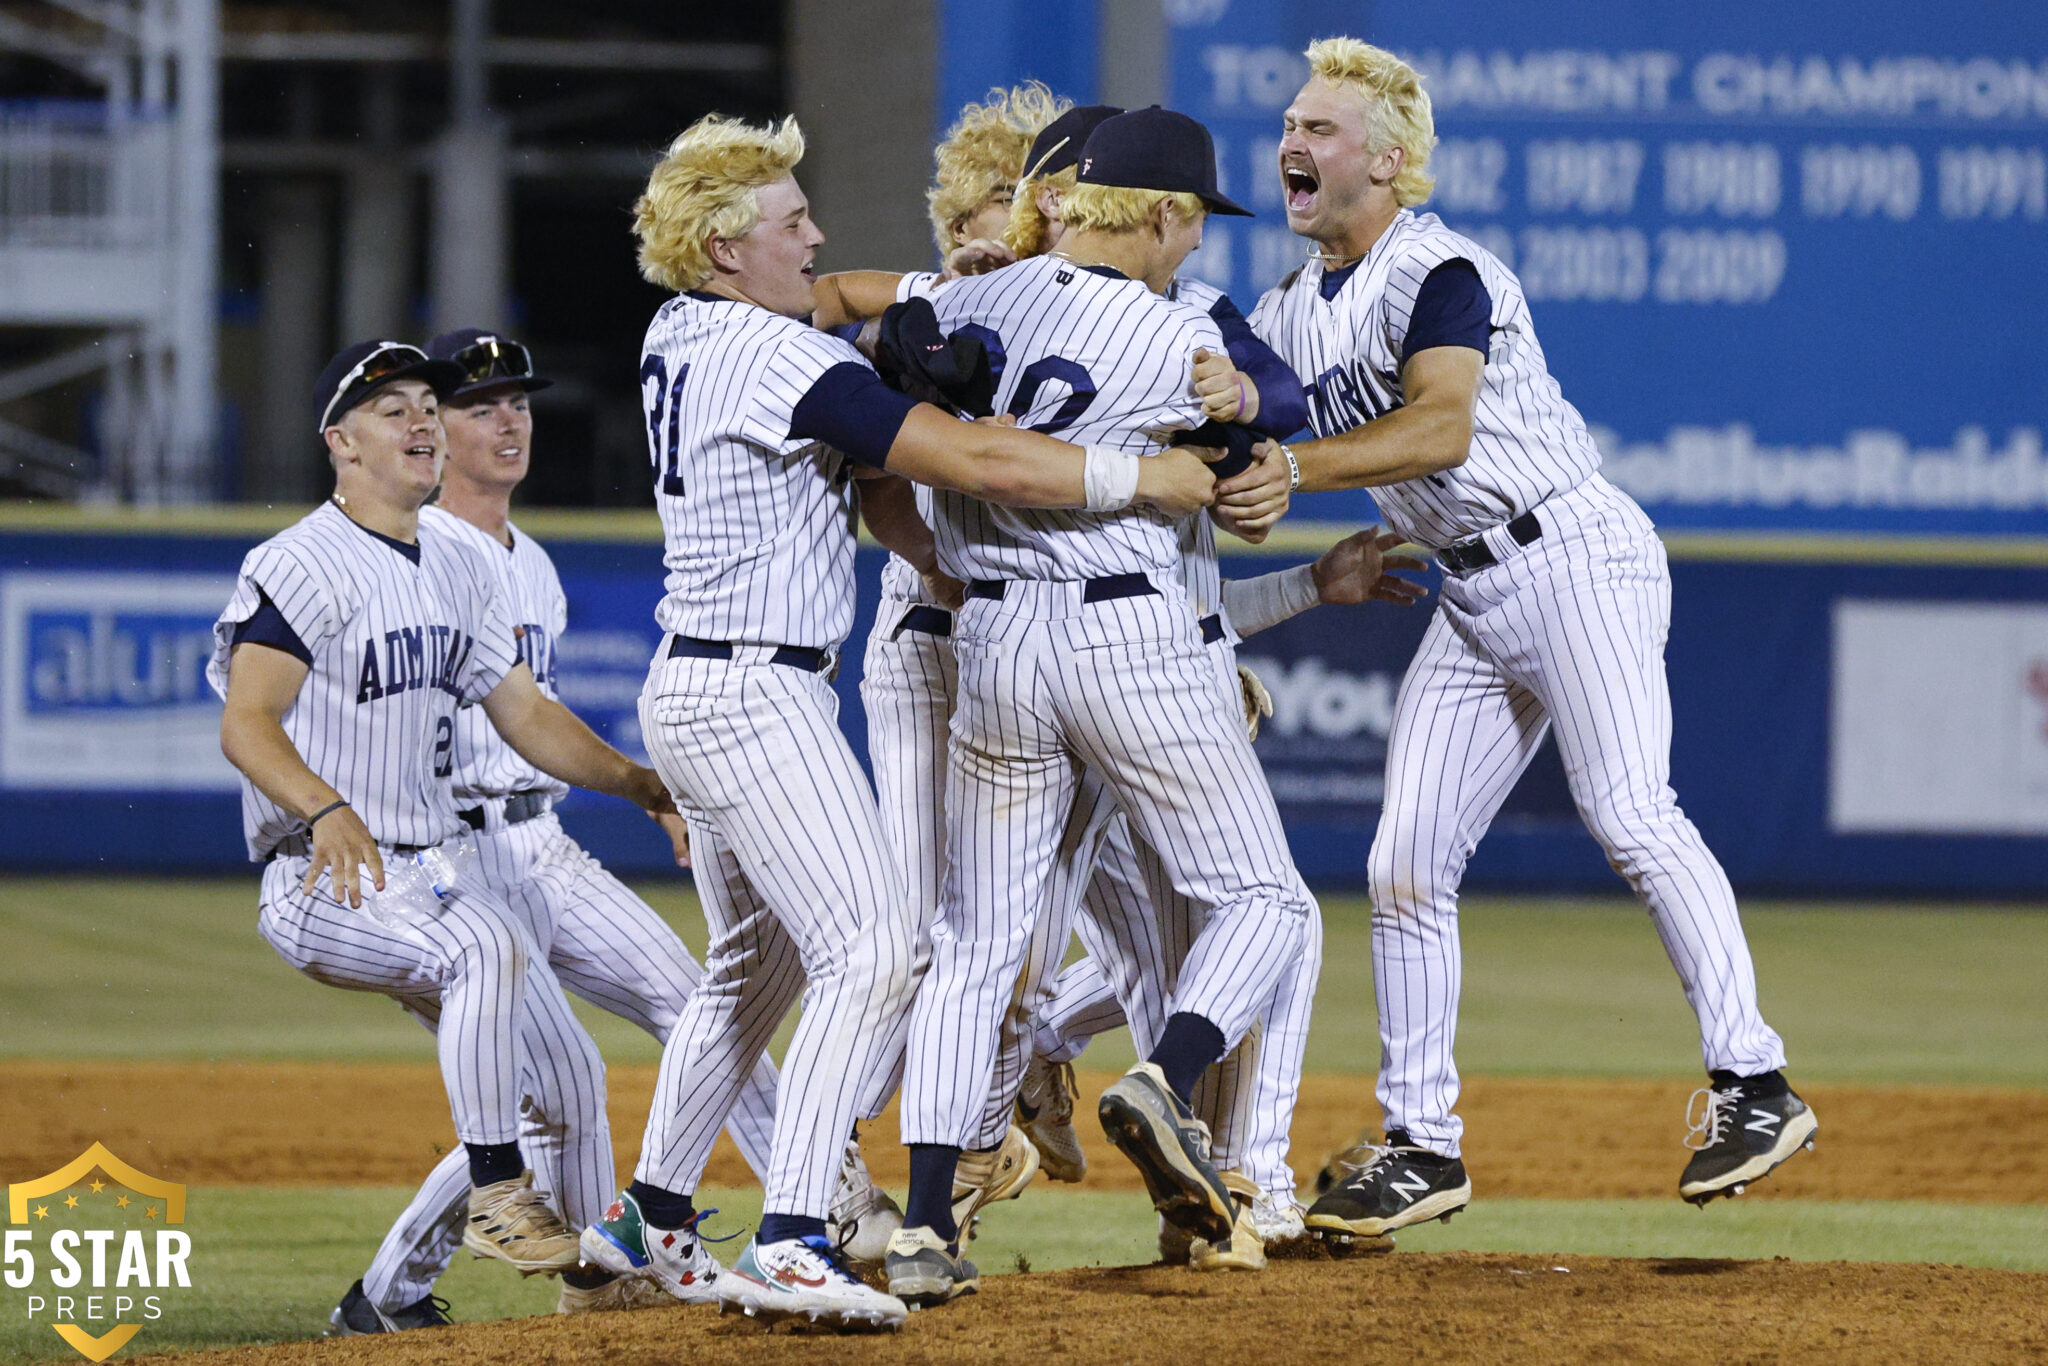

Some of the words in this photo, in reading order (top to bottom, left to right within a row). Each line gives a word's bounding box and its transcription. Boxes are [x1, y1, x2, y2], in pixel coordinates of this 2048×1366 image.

[640, 353, 686, 497] 31
[1744, 1108, 1781, 1137] N
[1389, 1168, 1431, 1204] N
